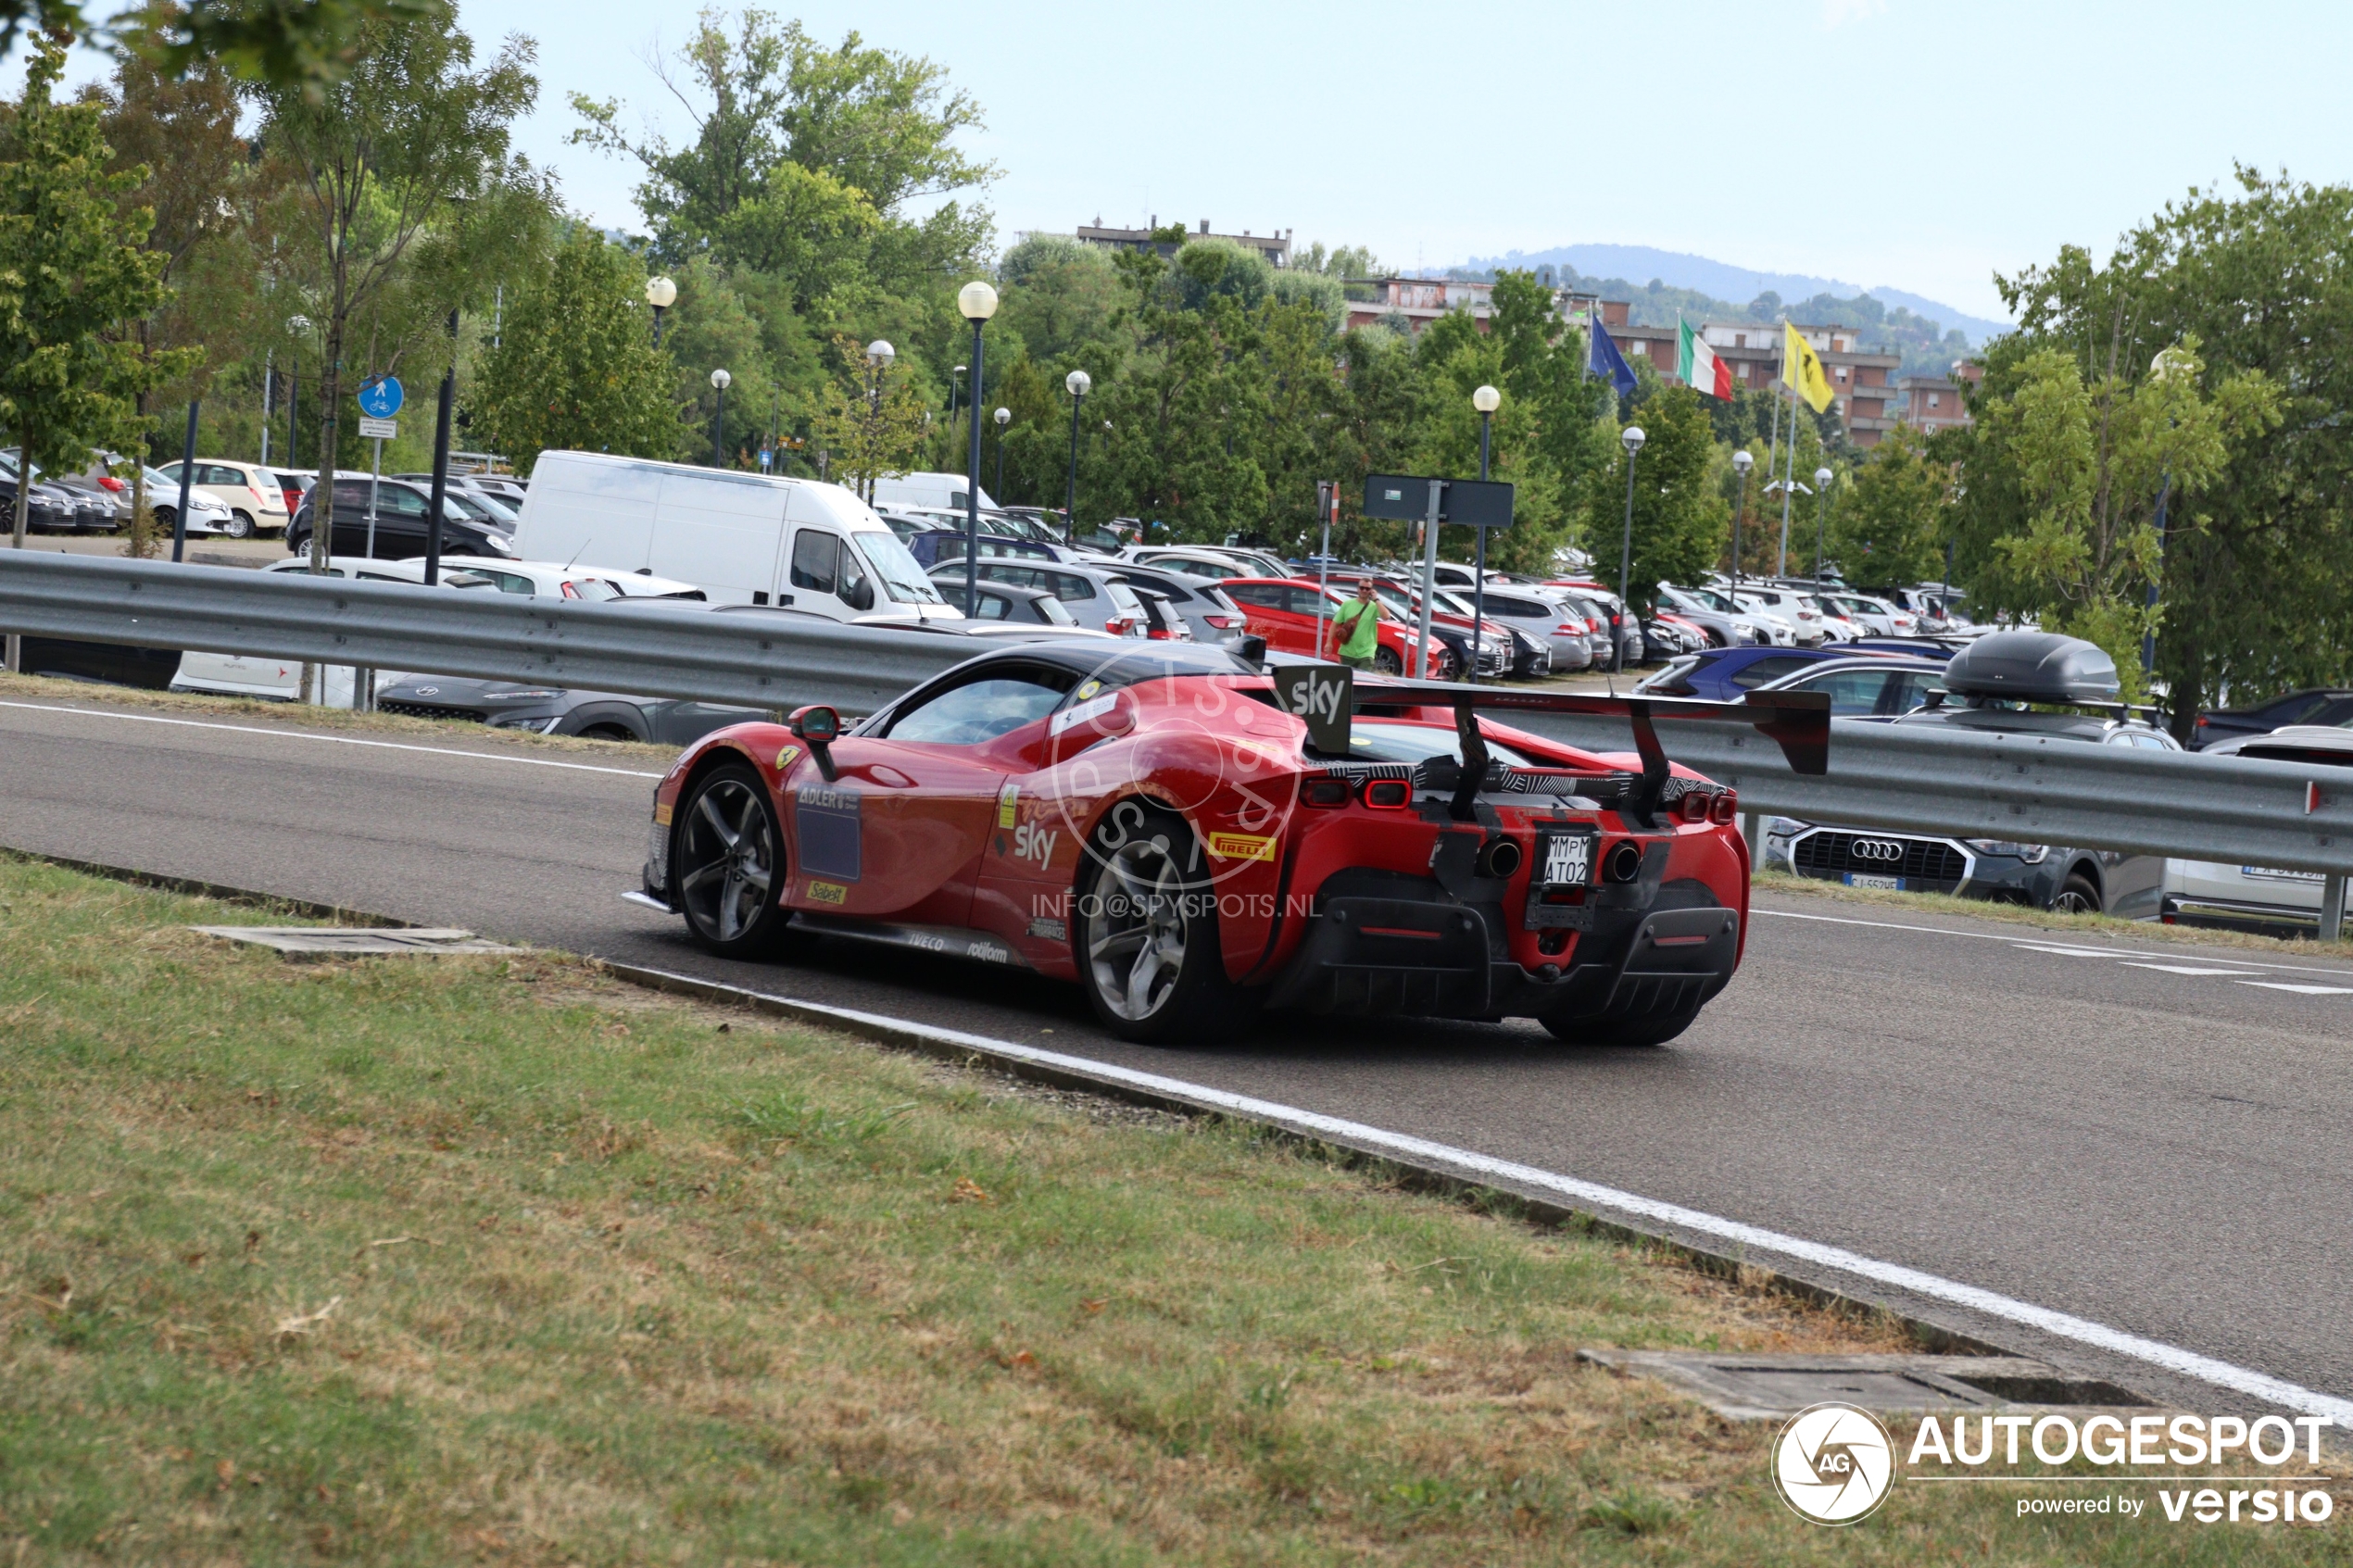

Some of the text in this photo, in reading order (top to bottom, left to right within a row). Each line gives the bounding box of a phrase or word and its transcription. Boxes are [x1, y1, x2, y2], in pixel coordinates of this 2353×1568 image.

[1291, 670, 1345, 725] sky
[798, 787, 837, 809] ADLER
[1014, 820, 1058, 872] sky
[1214, 836, 1268, 857] PIRELLI
[810, 882, 843, 903] Sabelt
[909, 934, 945, 952] IVECO
[967, 941, 1008, 964] rotiform
